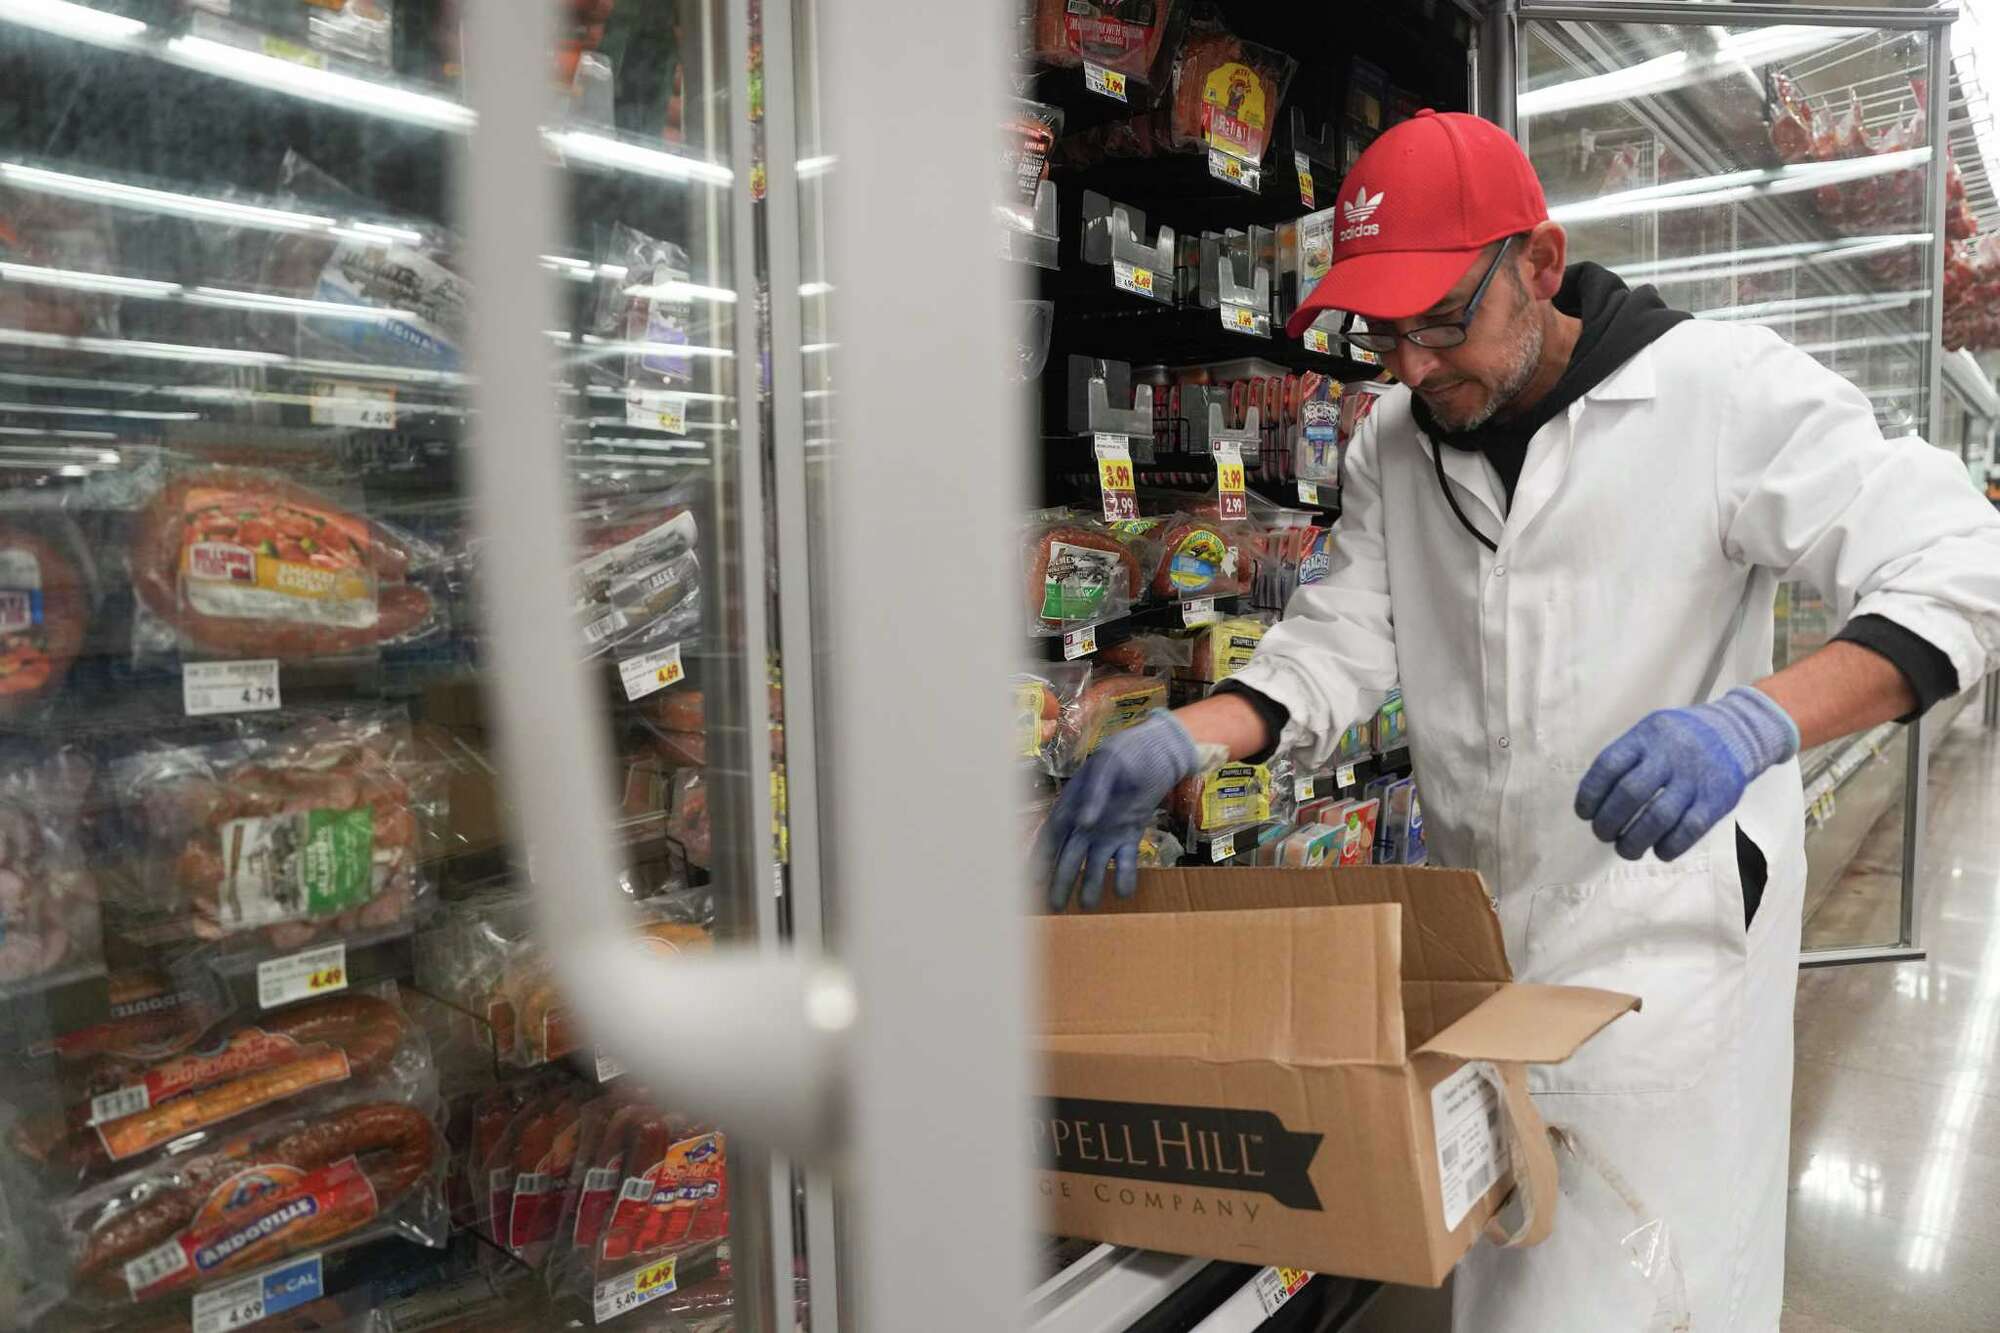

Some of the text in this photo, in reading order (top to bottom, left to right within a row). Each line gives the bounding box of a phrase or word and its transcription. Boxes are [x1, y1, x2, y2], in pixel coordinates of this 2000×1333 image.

[1340, 223, 1380, 242] adidas
[1105, 465, 1130, 487] 3.99
[1223, 469, 1242, 489] 3.99
[1112, 497, 1134, 514] 2.99
[1226, 498, 1242, 514] 2.99
[658, 663, 680, 684] 4.69
[242, 687, 275, 703] 4.79
[310, 968, 342, 990] 4.49
[1152, 1119, 1265, 1176] HILL
[1093, 1182, 1261, 1224] COMPANY
[200, 1197, 312, 1265] ANDOUILLE
[265, 1273, 317, 1300] LOCAL
[640, 1267, 671, 1289] 4.49
[615, 1290, 637, 1309] 5.49
[229, 1300, 263, 1323] 4.69
